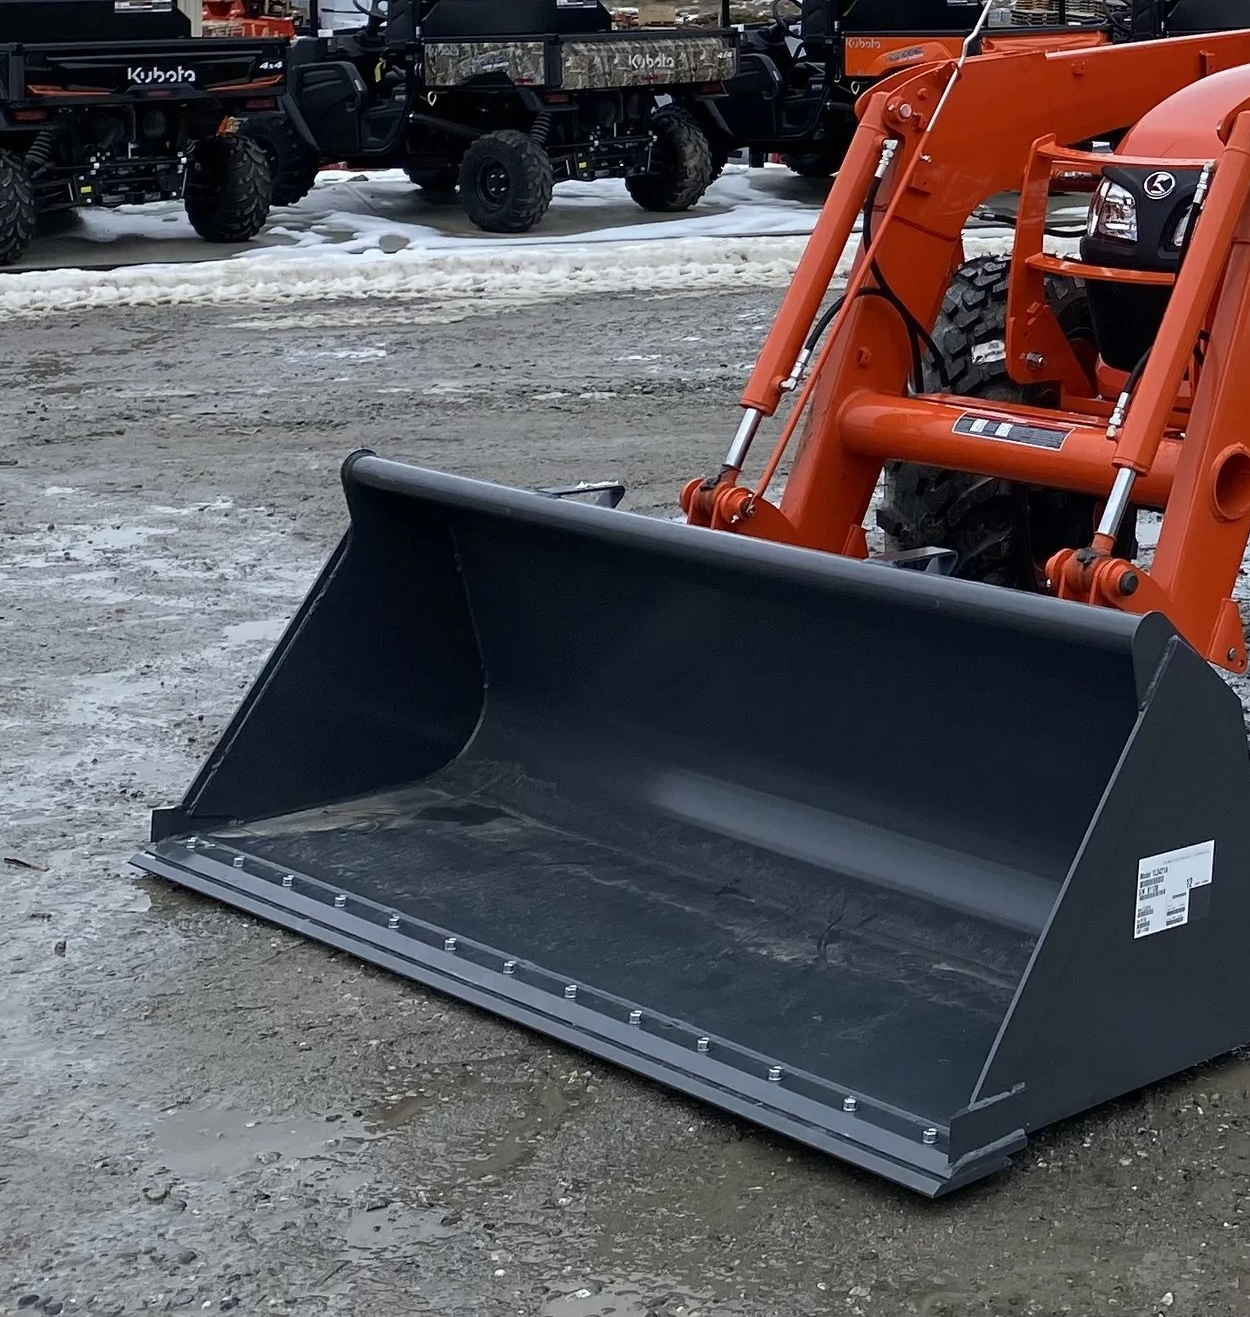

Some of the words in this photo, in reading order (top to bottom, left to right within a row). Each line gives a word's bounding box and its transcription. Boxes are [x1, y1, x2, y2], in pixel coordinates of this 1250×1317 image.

[845, 38, 881, 49] Kubota
[259, 61, 283, 70] 4x4
[628, 52, 674, 69] Kubota
[127, 65, 196, 84] Kubota
